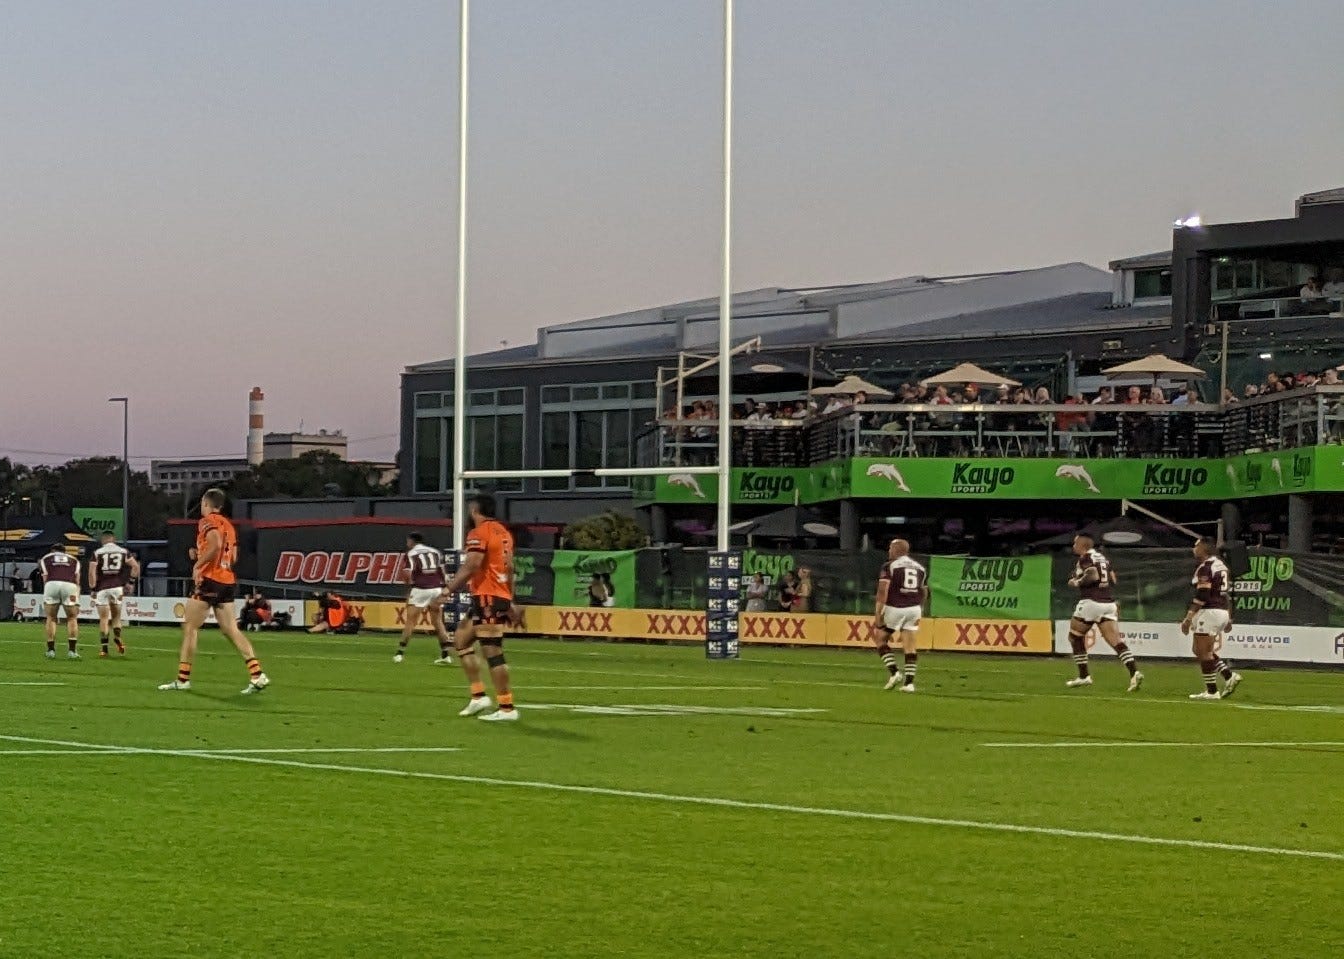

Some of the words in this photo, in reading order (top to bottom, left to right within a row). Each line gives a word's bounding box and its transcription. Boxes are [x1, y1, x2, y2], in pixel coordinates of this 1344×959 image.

[739, 471, 795, 493] Kayo
[951, 462, 1015, 493] Kayo
[1144, 463, 1208, 495] Kayo
[101, 552, 123, 571] 13
[274, 550, 410, 585] DOLPHI
[418, 553, 437, 570] 11
[743, 549, 794, 586] Kayo
[903, 567, 919, 590] 6
[961, 558, 1024, 592] Kayo
[1241, 556, 1294, 592] ayo
[960, 583, 995, 591] SPORTS
[956, 595, 1019, 609] STADIUM
[1233, 596, 1291, 610] ADIUM
[558, 611, 612, 632] XXXX
[647, 614, 707, 635] XXXX
[743, 617, 806, 639] XXXX
[955, 623, 1029, 647] XXXX
[1119, 632, 1159, 640] SWIDE
[1227, 635, 1291, 644] AUSWIDE
